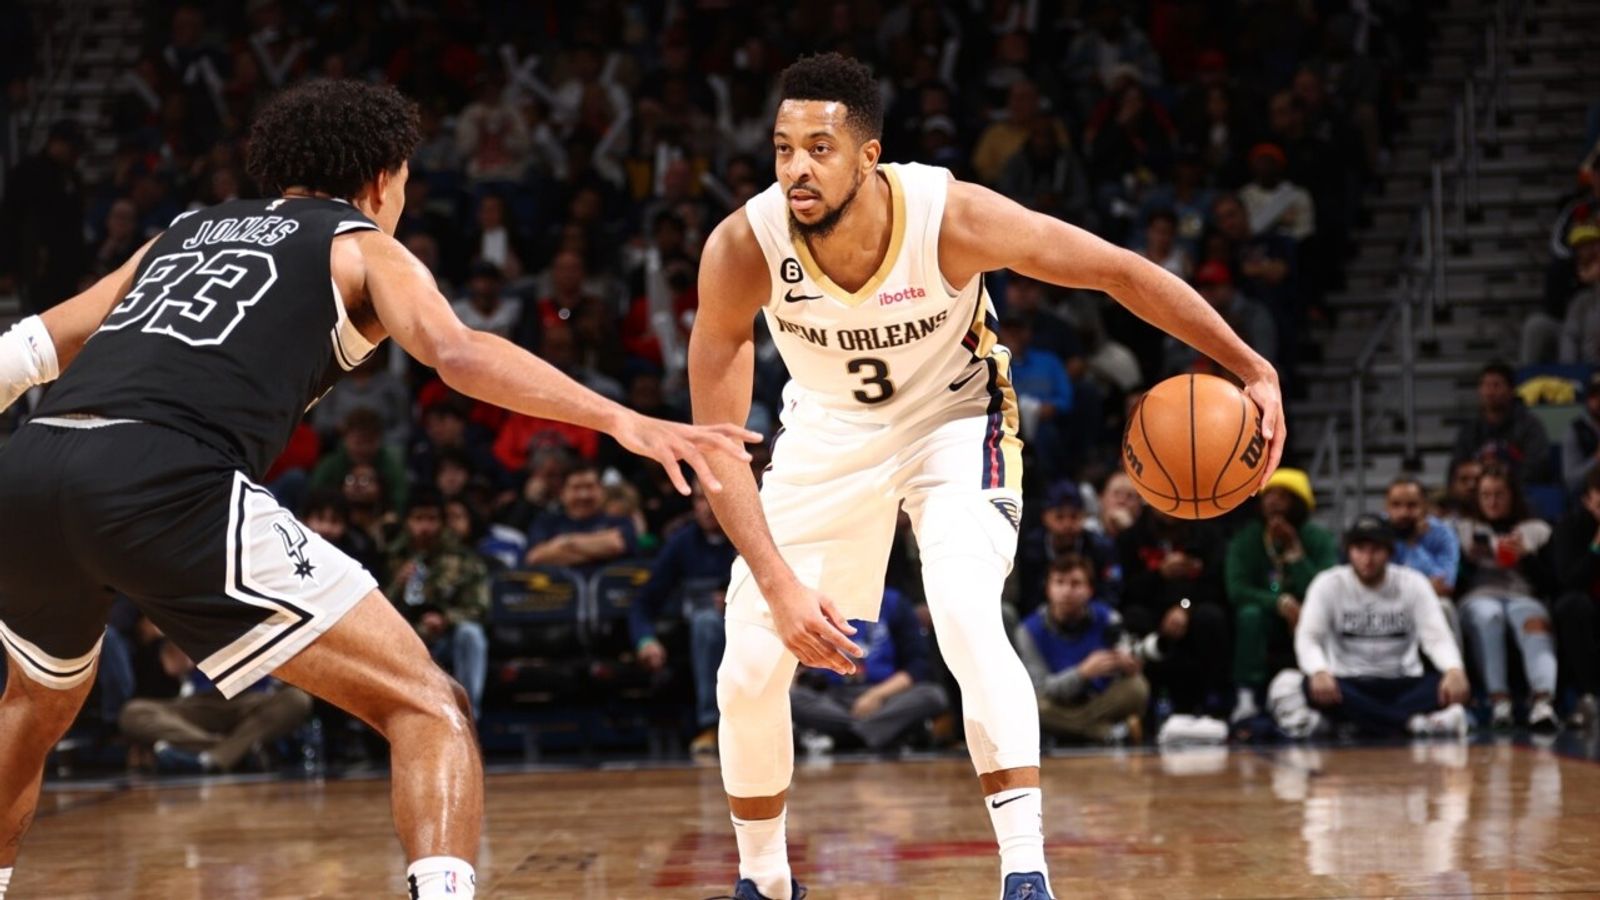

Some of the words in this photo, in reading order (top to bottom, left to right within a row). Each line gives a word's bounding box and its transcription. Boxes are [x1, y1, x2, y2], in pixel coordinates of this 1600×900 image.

[182, 216, 299, 250] JONES
[100, 249, 279, 347] 33
[878, 286, 926, 306] ibotta
[775, 314, 828, 347] NEW
[837, 310, 948, 351] ORLEANS
[846, 357, 896, 404] 3
